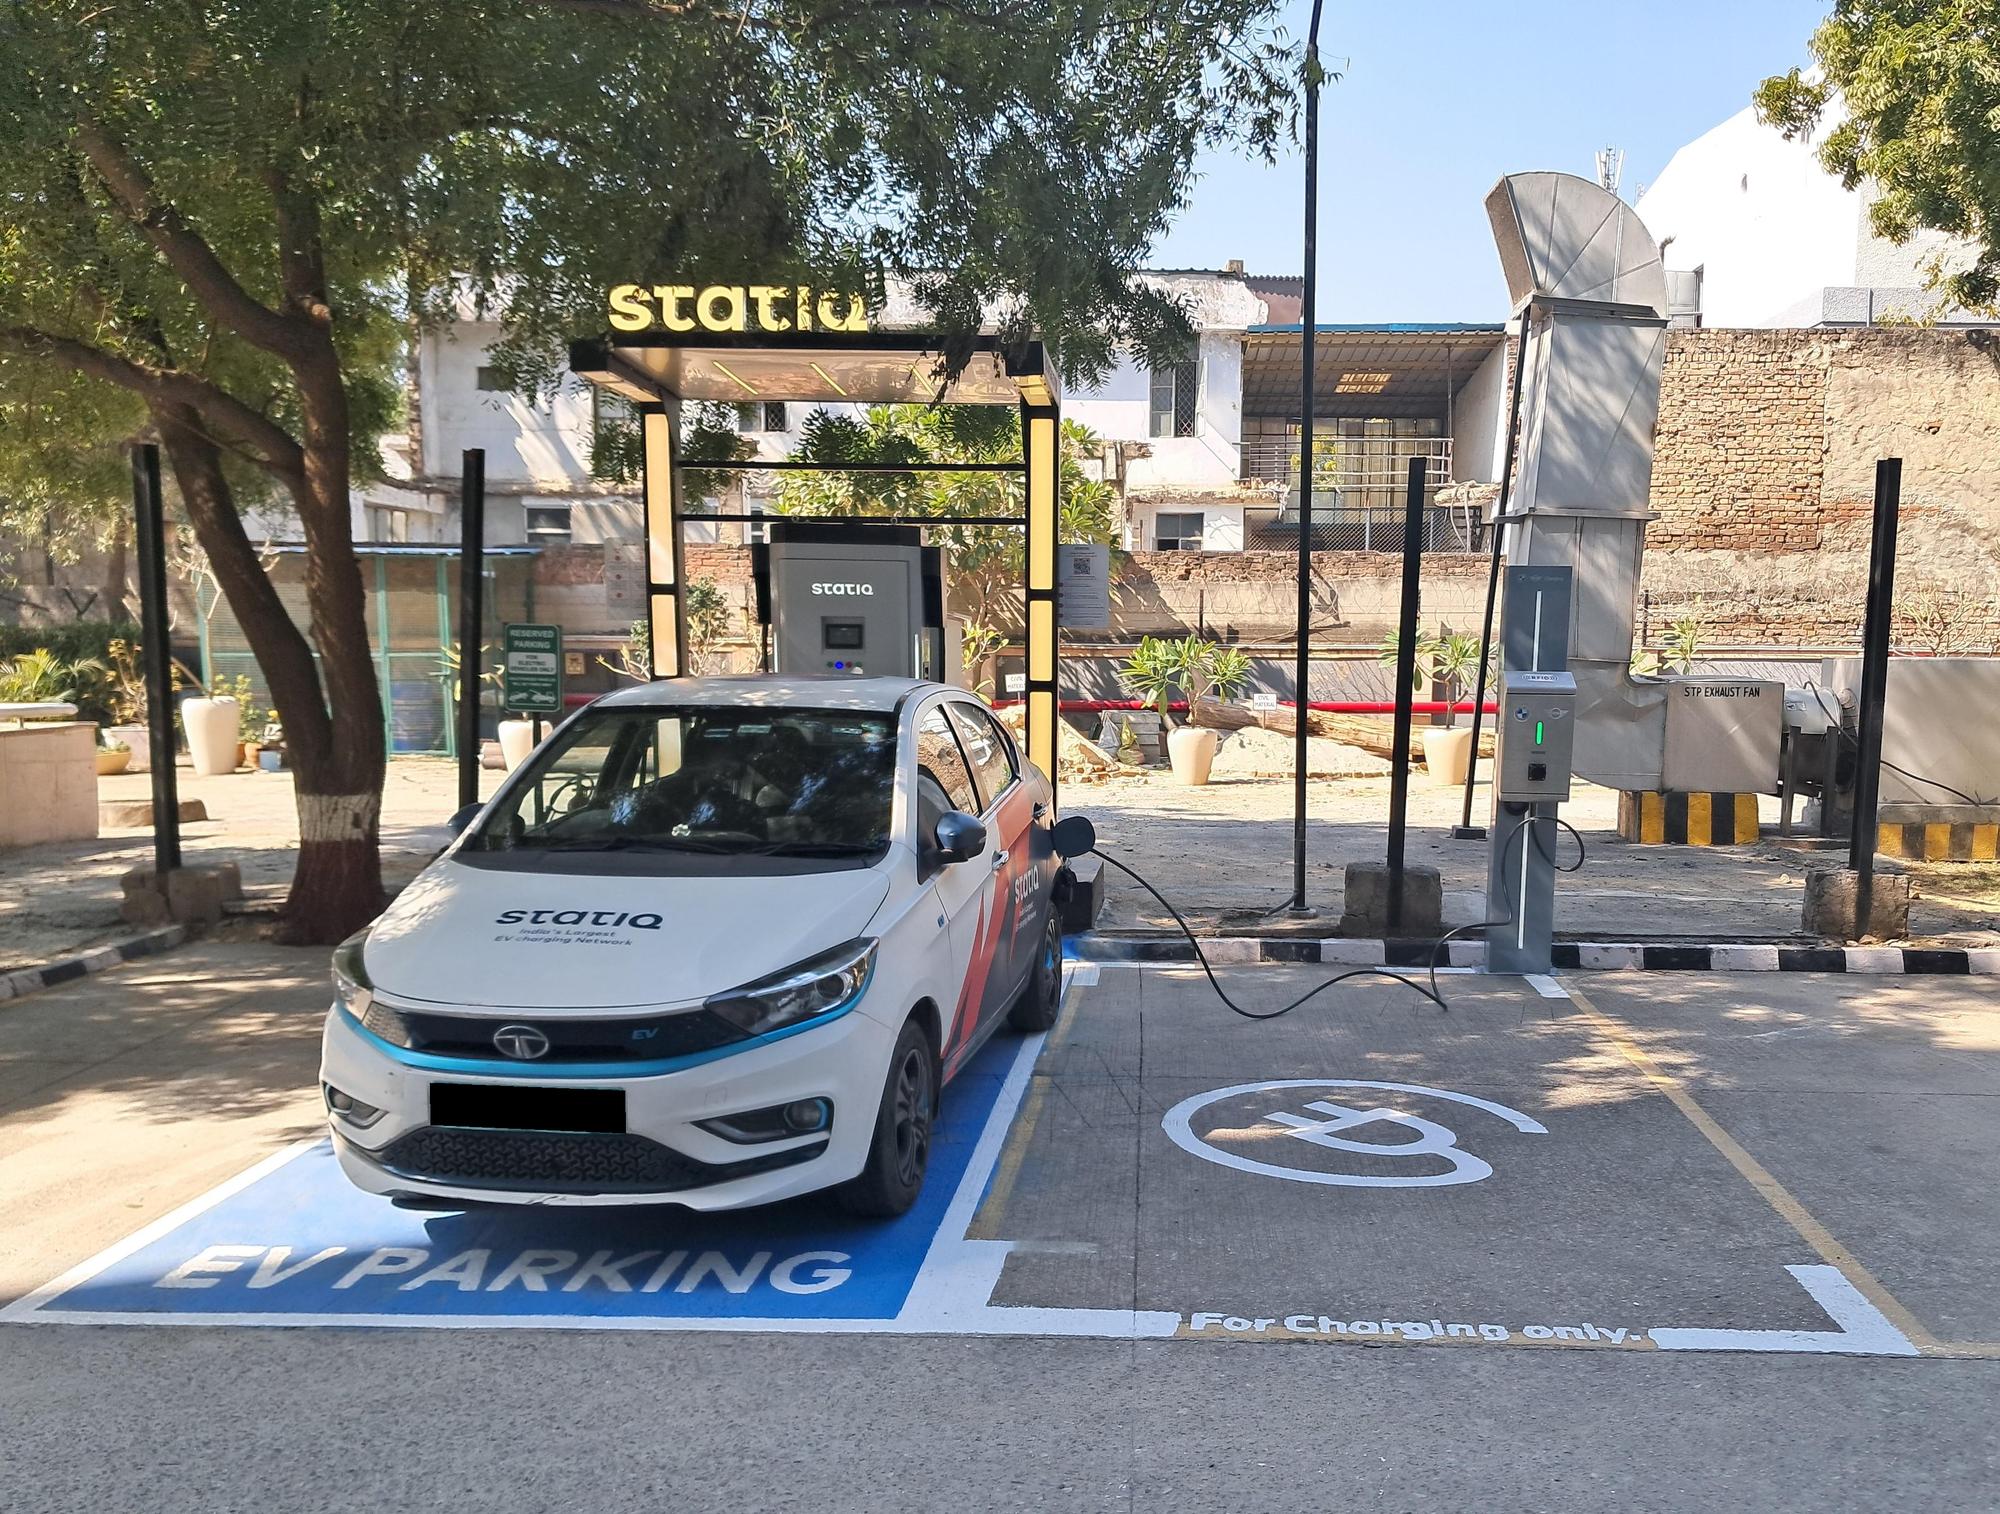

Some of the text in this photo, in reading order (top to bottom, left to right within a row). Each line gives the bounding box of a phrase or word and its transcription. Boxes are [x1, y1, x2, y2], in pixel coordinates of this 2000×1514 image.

[510, 629, 554, 638] RESERVED
[513, 640, 551, 649] PARKING
[1684, 686, 1761, 698] STP EXHAUST FAN
[565, 929, 617, 938] Largest
[575, 937, 633, 946] Network
[632, 1028, 659, 1040] EV
[153, 1245, 853, 1295] EV PARKING
[1190, 1312, 1642, 1345] For Charging only.
